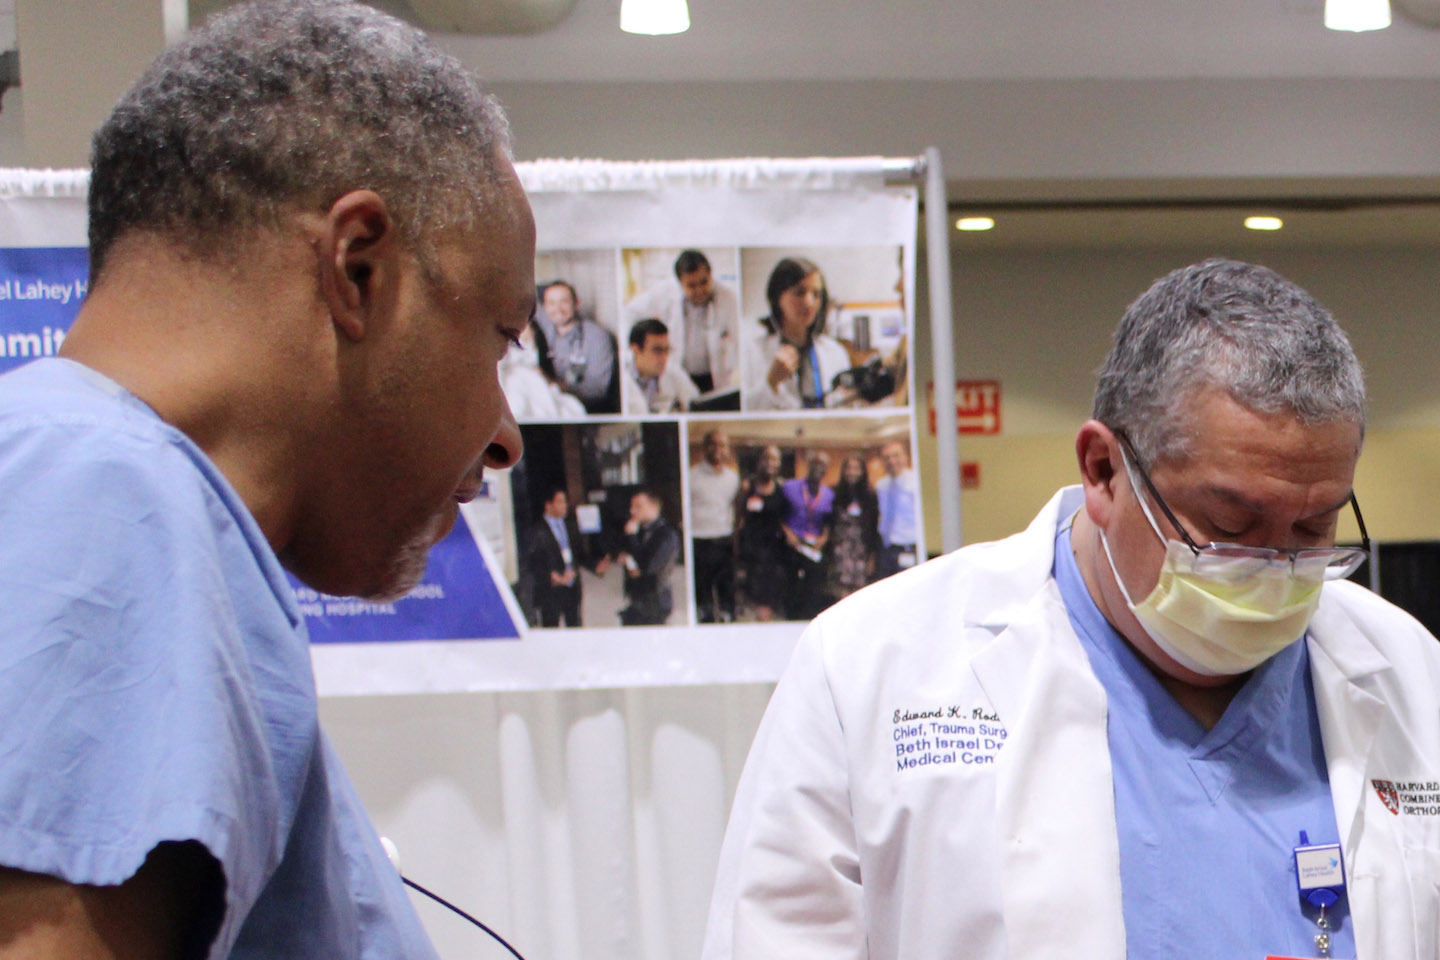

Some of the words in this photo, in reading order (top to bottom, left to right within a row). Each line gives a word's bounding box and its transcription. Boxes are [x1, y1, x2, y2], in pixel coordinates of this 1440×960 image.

[14, 279, 73, 304] Lahey
[893, 707, 942, 724] Edward
[947, 705, 967, 720] K.
[893, 723, 927, 742] Chief,
[930, 722, 975, 735] Trauma
[979, 724, 1008, 740] Surg
[896, 738, 931, 757] Beth
[936, 737, 980, 750] Israel
[897, 752, 956, 772] Medical
[962, 752, 996, 764] Cen
[1397, 782, 1440, 792] HARVARD
